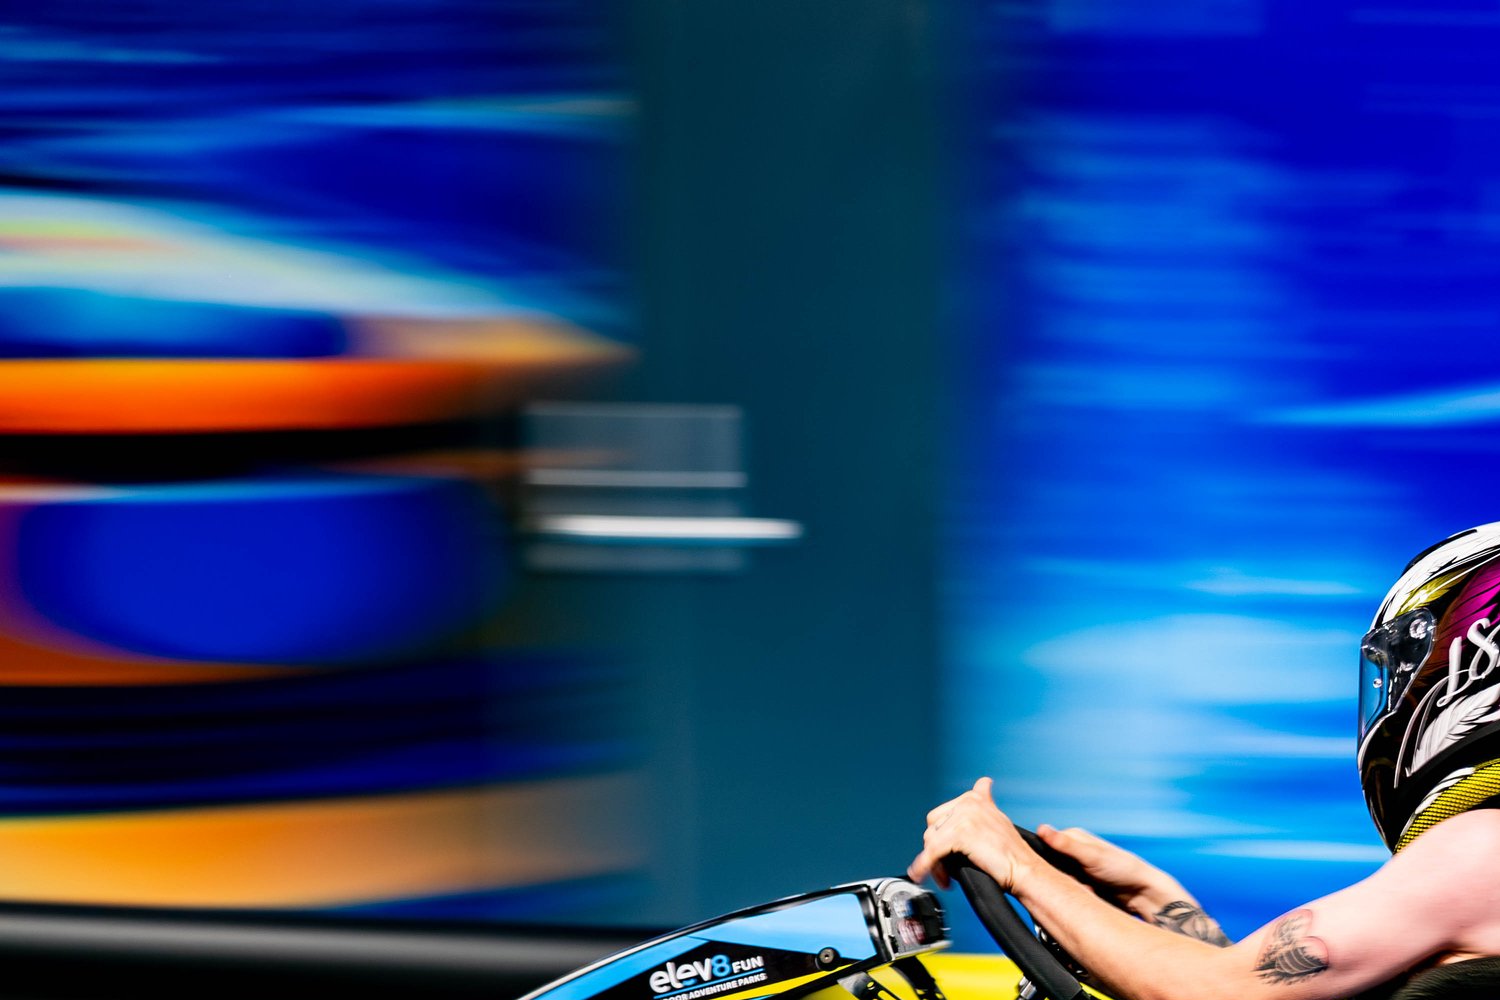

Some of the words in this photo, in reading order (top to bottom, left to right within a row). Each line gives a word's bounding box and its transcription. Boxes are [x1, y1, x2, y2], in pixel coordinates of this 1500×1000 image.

[649, 954, 731, 994] elev8
[732, 955, 764, 974] FUN
[688, 981, 738, 1000] ADVENTURE
[738, 972, 768, 987] PARKS
